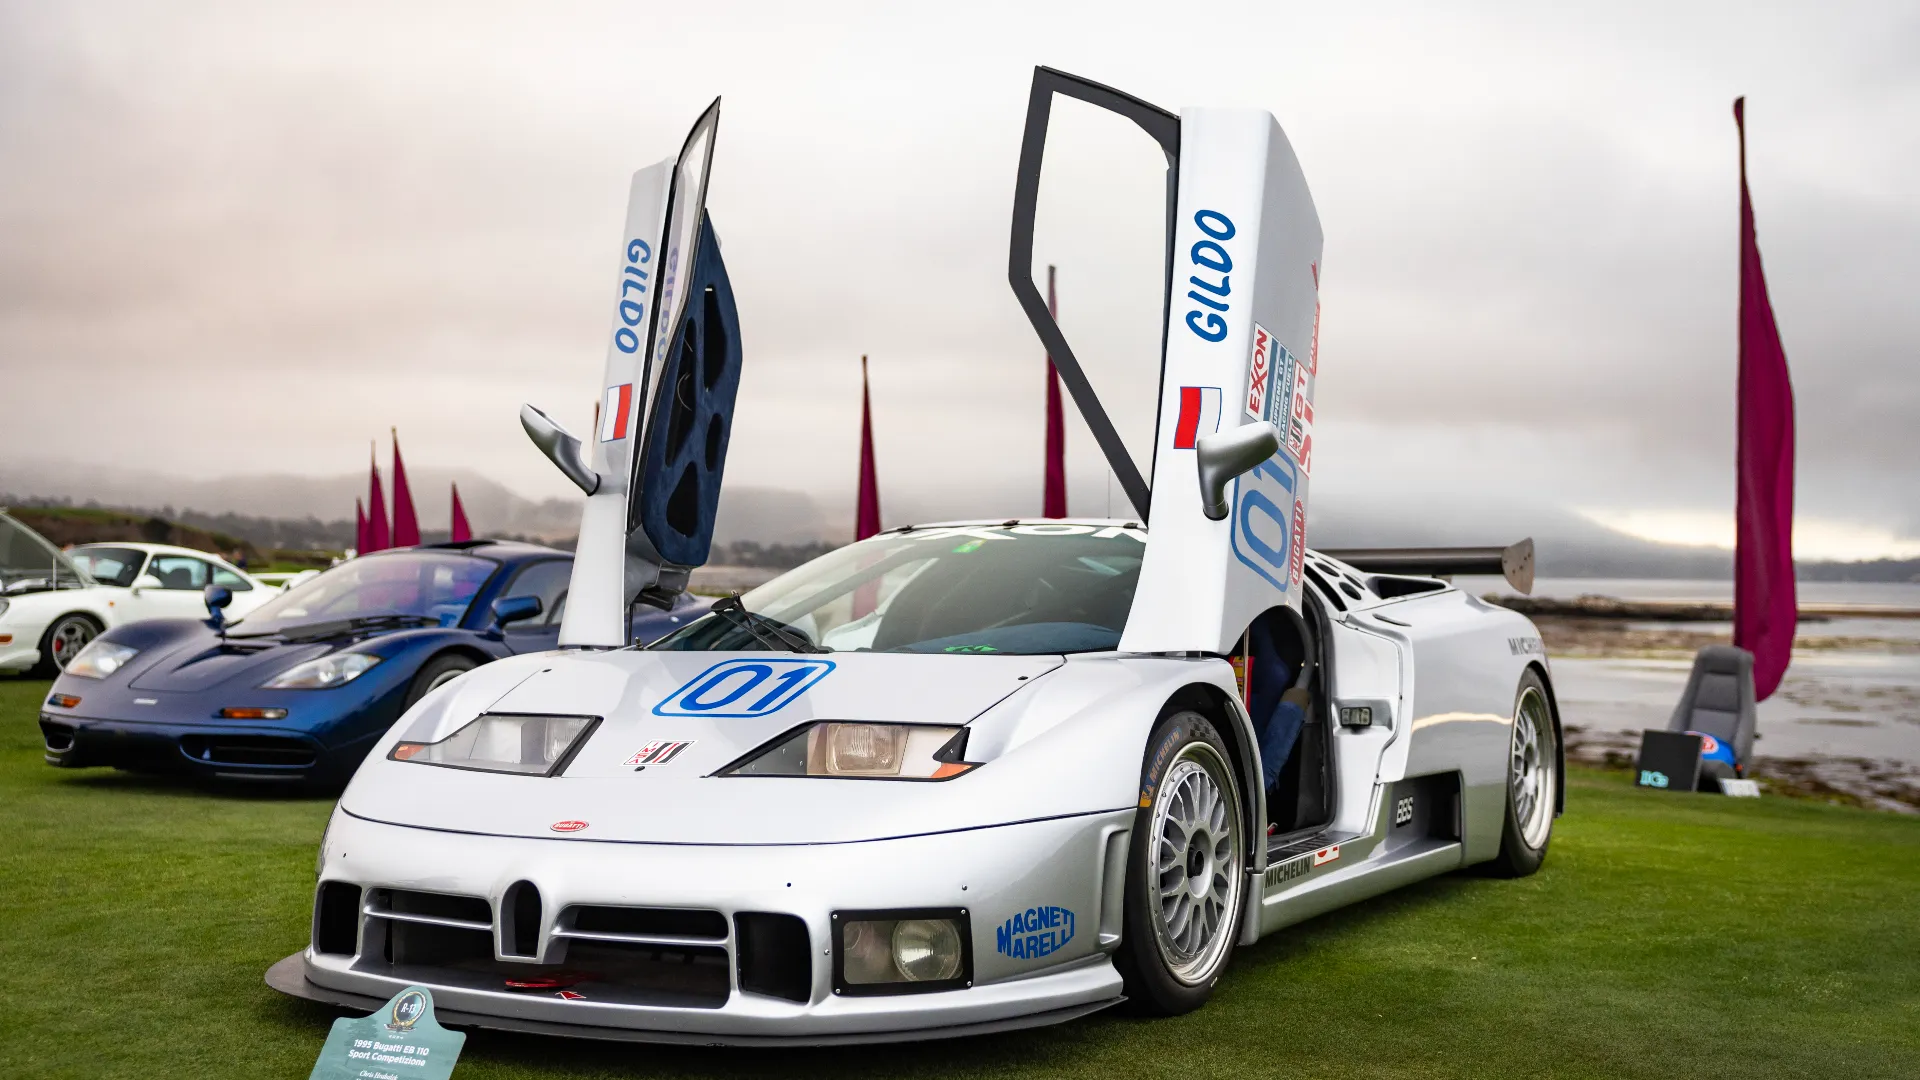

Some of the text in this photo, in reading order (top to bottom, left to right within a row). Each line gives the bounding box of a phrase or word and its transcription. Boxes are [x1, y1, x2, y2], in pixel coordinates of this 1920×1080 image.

[615, 238, 651, 354] GILDO
[1185, 209, 1236, 342] GILDO
[1249, 329, 1268, 414] EXXON
[1294, 367, 1306, 420] GT
[1272, 378, 1283, 427] UPREME
[1280, 356, 1294, 441] RACING FUELS
[1291, 503, 1304, 580] BUGATTI
[680, 664, 819, 711] 01
[1149, 730, 1180, 783] MICHELIN
[1396, 797, 1413, 824] BBS
[1265, 856, 1311, 889] MICHELIN
[997, 906, 1075, 942] MAGNETI
[997, 924, 1075, 959] MARELLI
[401, 1002, 417, 1013] R-13
[348, 1049, 426, 1066] Sport Competizione
[353, 1039, 430, 1056] 1995 Bugatti EB 110
